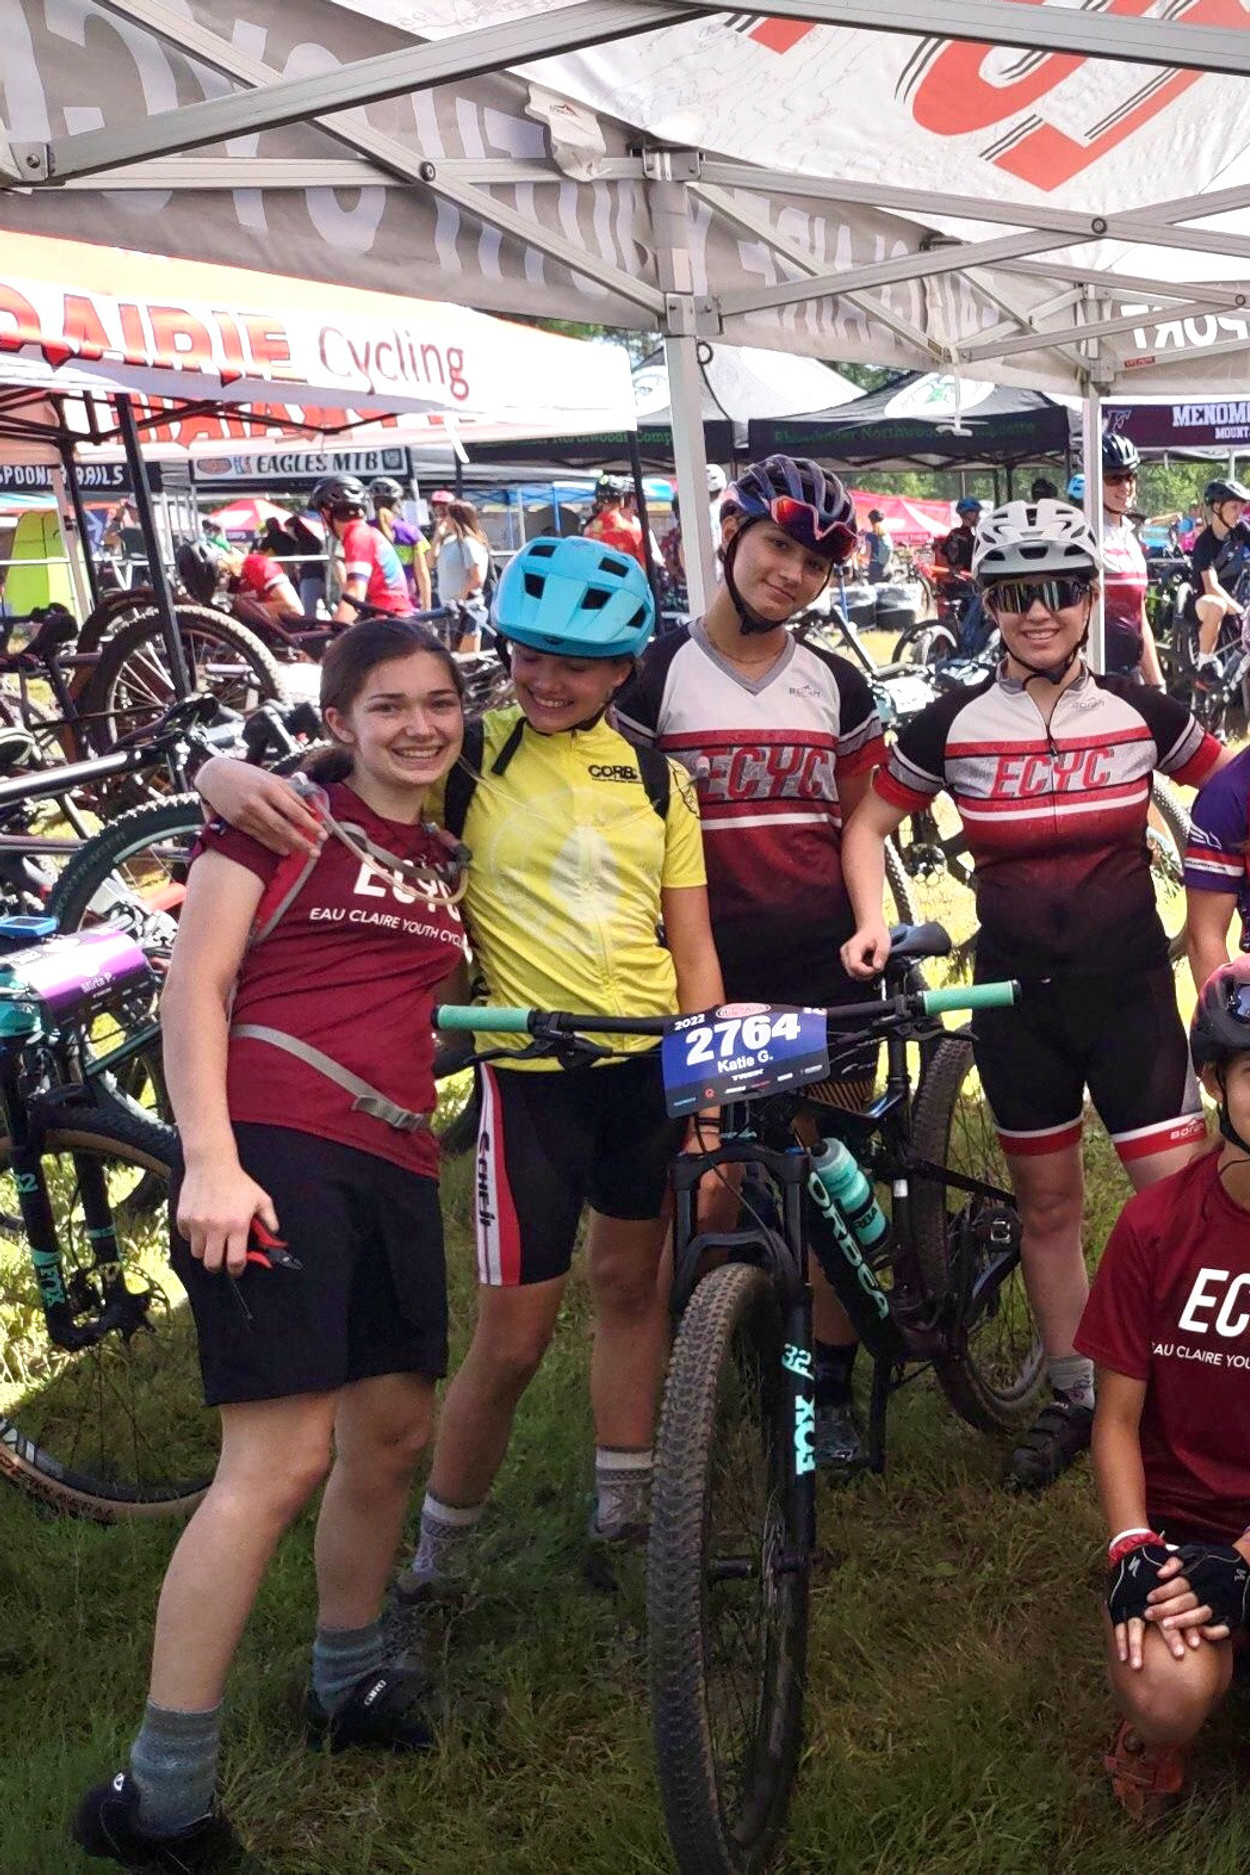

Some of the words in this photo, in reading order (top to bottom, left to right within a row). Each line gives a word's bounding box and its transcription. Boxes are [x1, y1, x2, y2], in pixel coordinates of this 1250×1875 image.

[318, 325, 470, 401] Cycling
[257, 453, 327, 474] EAGLES
[332, 451, 378, 471] MTB
[990, 748, 1114, 798] ECYC
[310, 907, 346, 921] EAU
[349, 909, 402, 929] CLAIRE
[402, 918, 439, 939] YOUTH
[674, 1013, 706, 1031] 2022
[685, 1013, 801, 1067] 2764
[717, 1055, 755, 1073] Katie
[757, 1050, 774, 1064] G.
[1152, 1342, 1175, 1357] AU
[1176, 1345, 1223, 1366] CLAIRE
